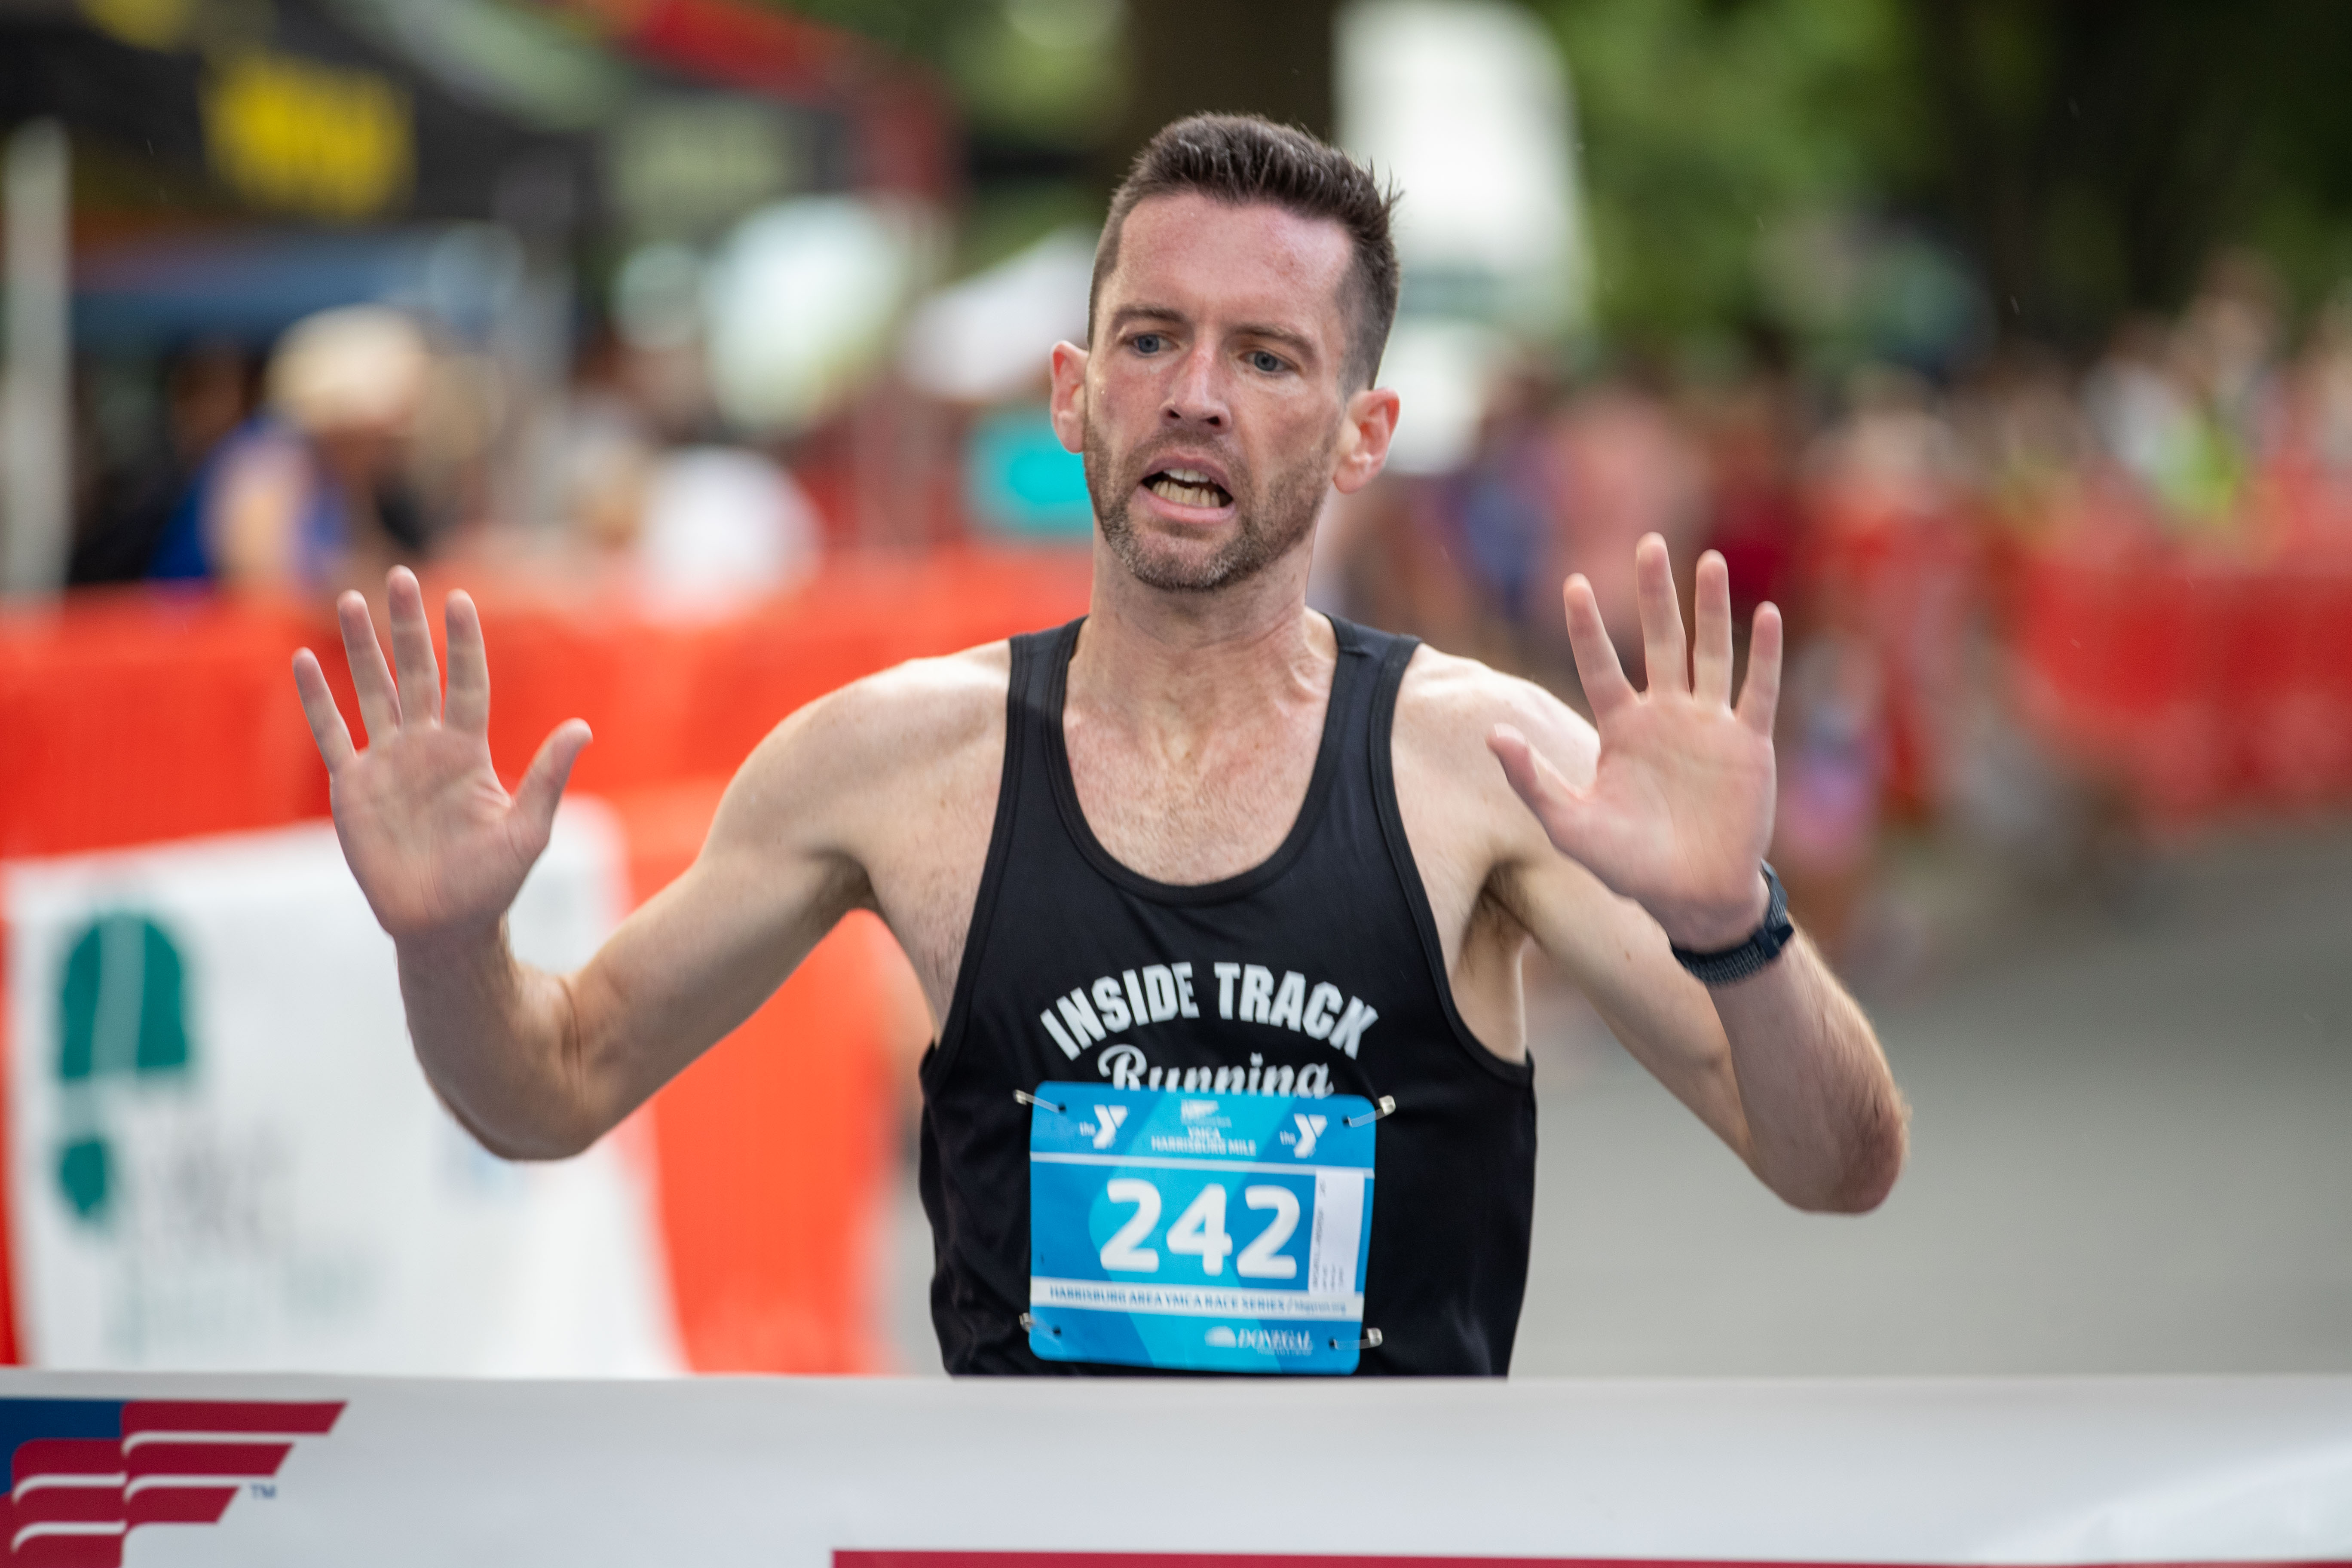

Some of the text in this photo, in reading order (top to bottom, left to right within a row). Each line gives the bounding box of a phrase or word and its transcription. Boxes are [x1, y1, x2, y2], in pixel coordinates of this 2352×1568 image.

[1040, 962, 1378, 1060] INSIDE TRACK
[1151, 1136, 1256, 1157] HARRISBURG MILE
[1100, 1178, 1300, 1279] 242
[1050, 1285, 1126, 1303] HARRISBURG
[1130, 1290, 1162, 1307] AREA
[1164, 1291, 1202, 1308] YMCA
[1205, 1294, 1238, 1310] RACE
[1242, 1296, 1285, 1313] SERIES
[251, 1484, 277, 1499] TM
